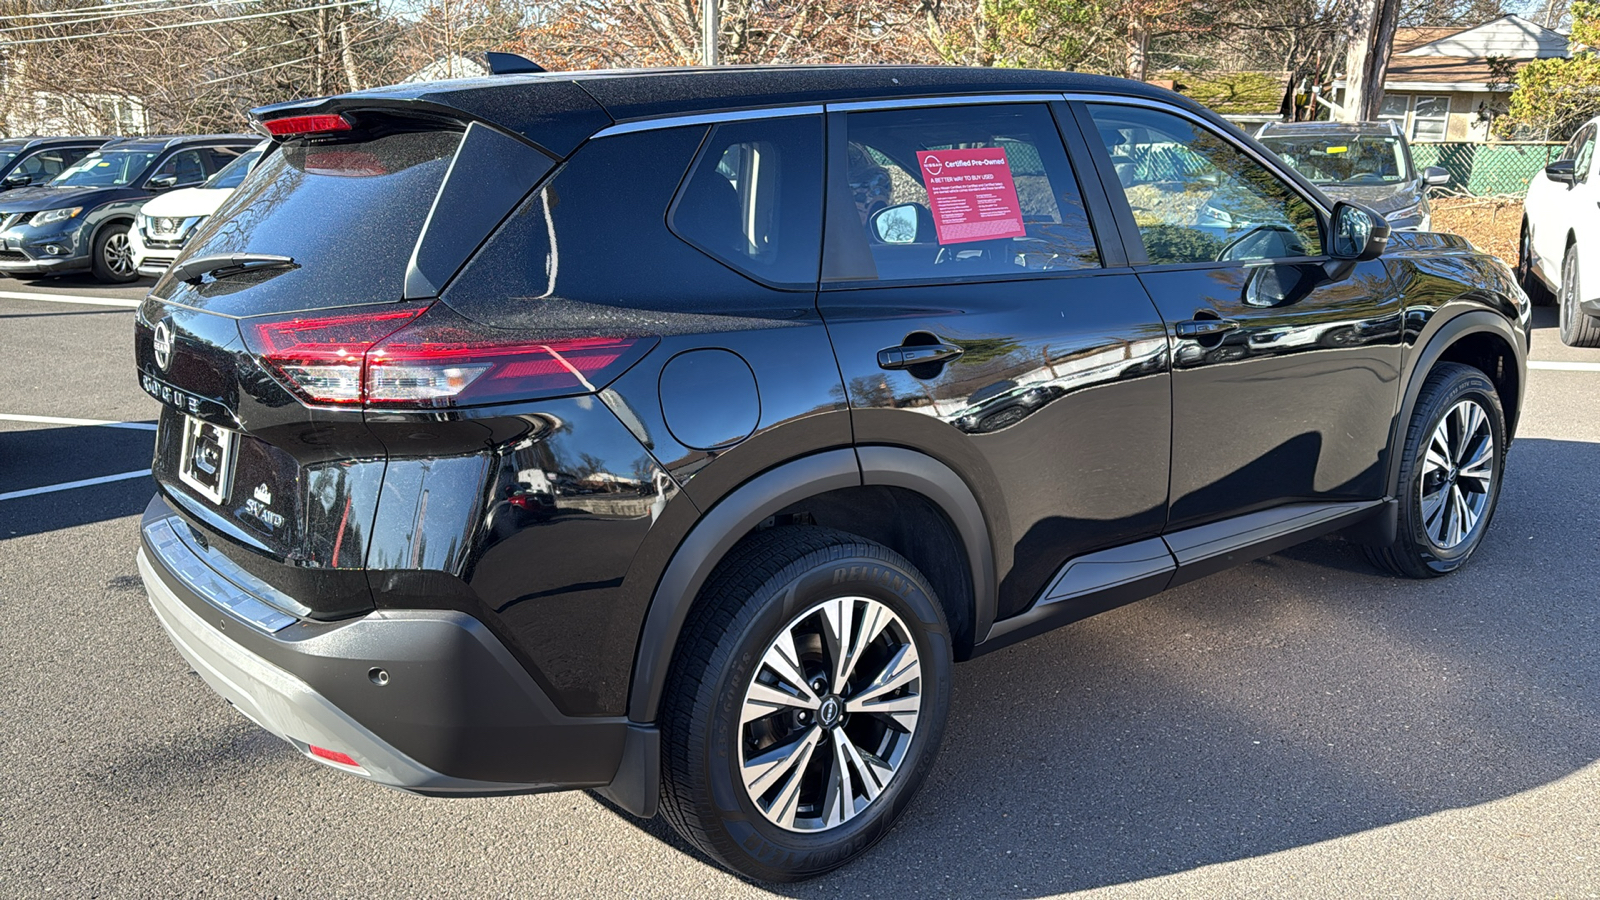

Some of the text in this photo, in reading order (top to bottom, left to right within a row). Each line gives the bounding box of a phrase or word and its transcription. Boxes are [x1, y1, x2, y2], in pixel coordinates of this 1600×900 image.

[945, 158, 1005, 168] Certified Pre-Owned
[142, 374, 201, 413] ROGUE
[245, 498, 285, 528] SV AWD
[832, 565, 916, 598] RELIANT
